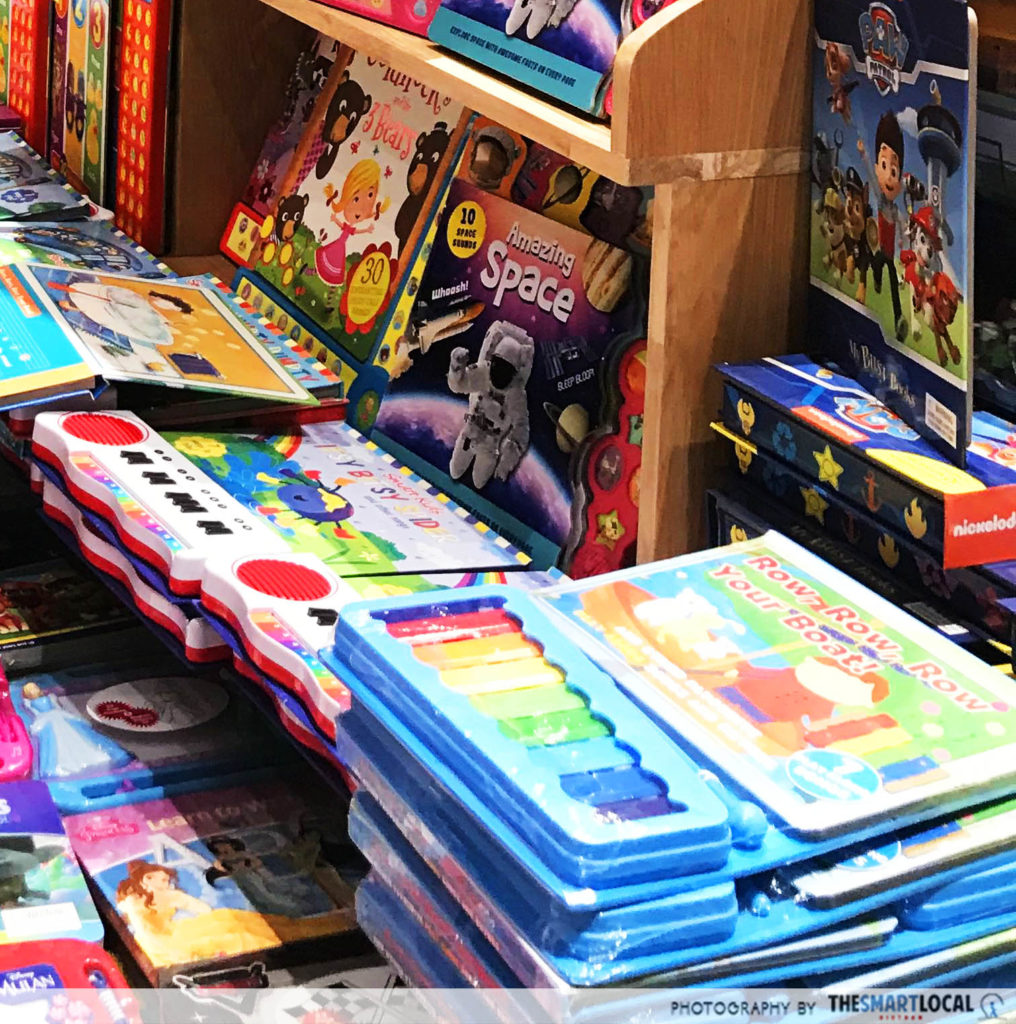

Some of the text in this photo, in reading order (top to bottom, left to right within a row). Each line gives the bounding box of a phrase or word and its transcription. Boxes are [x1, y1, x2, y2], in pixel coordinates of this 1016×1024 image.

[93, 1, 102, 45] 3
[456, 228, 478, 239] SPACE
[460, 207, 477, 226] 10
[452, 238, 478, 251] SOUNDS
[506, 221, 576, 277] Amazing
[360, 257, 385, 285] 30
[480, 239, 576, 323] Space
[431, 279, 470, 300] Whoosh!
[708, 563, 882, 676] Your Boat!
[908, 661, 992, 713] Row
